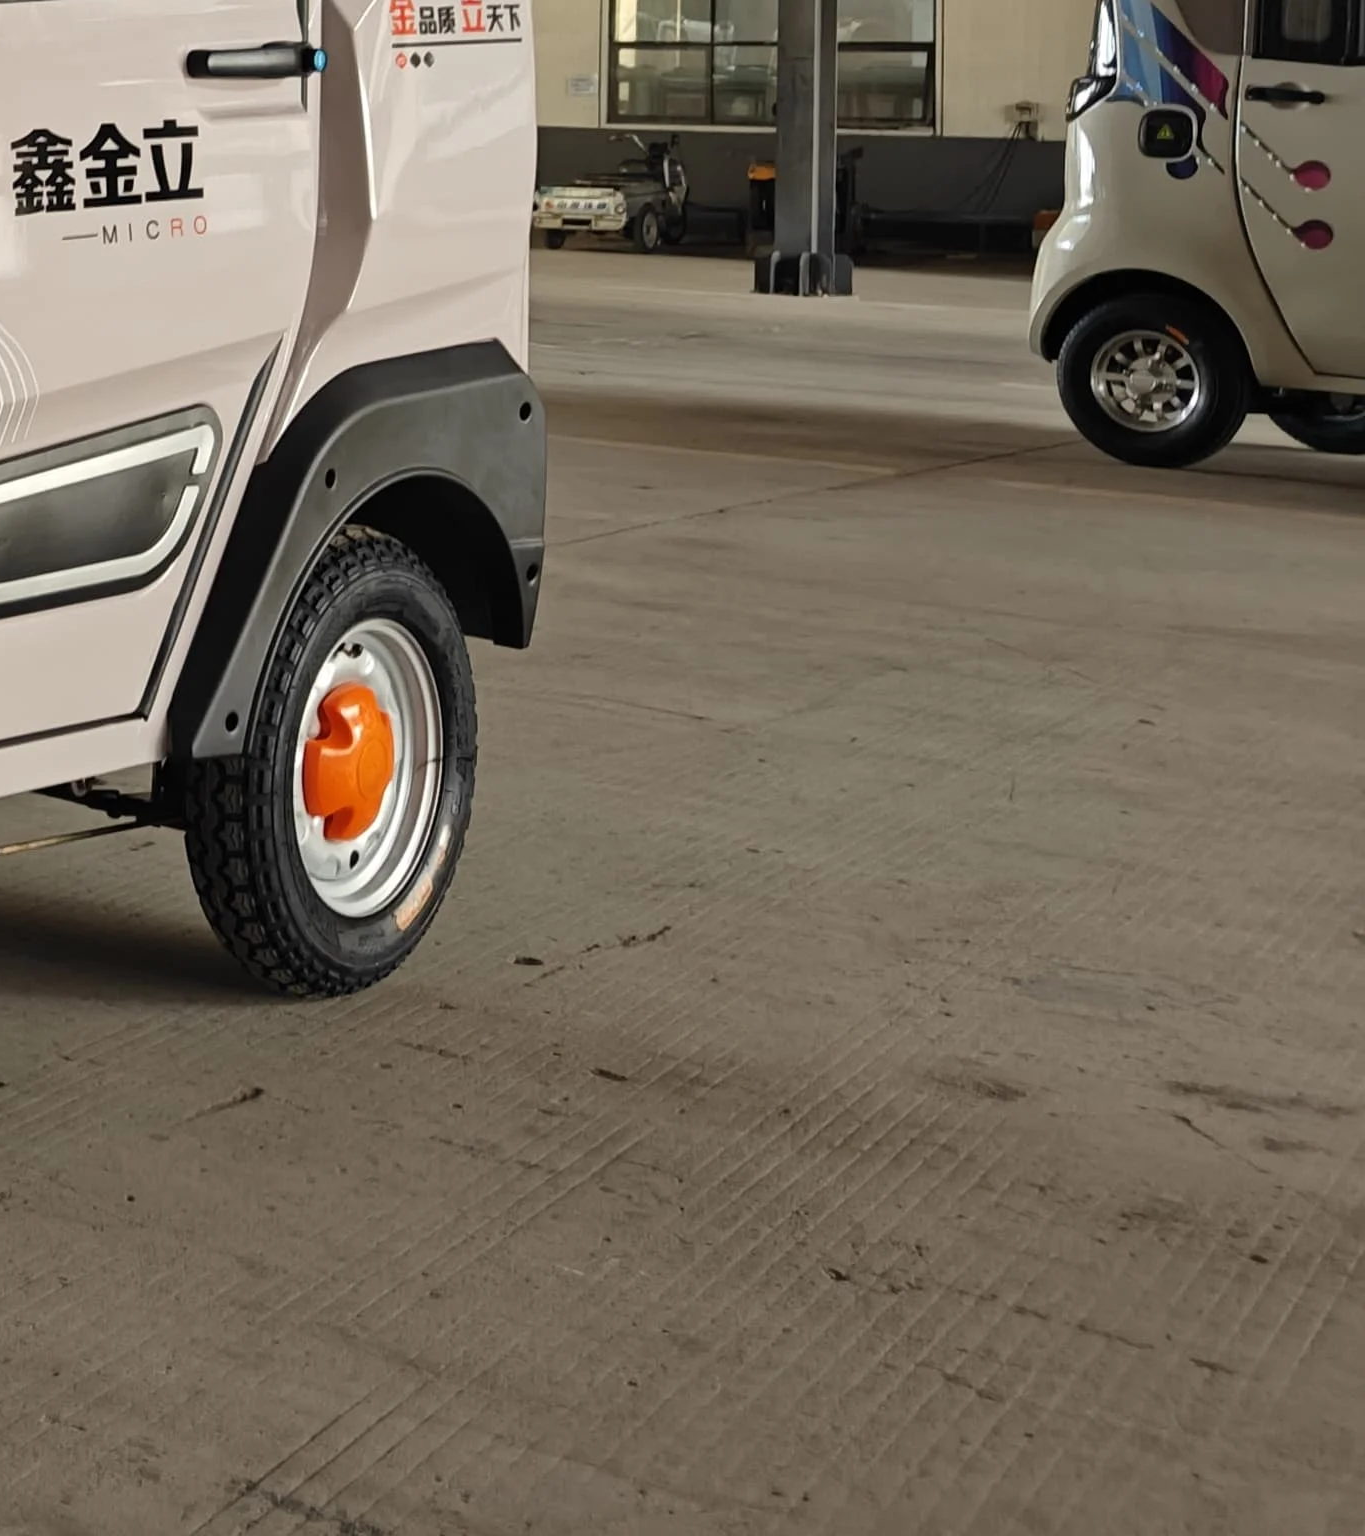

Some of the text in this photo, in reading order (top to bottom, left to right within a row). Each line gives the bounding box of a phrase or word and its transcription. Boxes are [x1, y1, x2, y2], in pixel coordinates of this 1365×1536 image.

[10, 118, 205, 217] 鑫金立
[101, 215, 208, 245] MICRO
